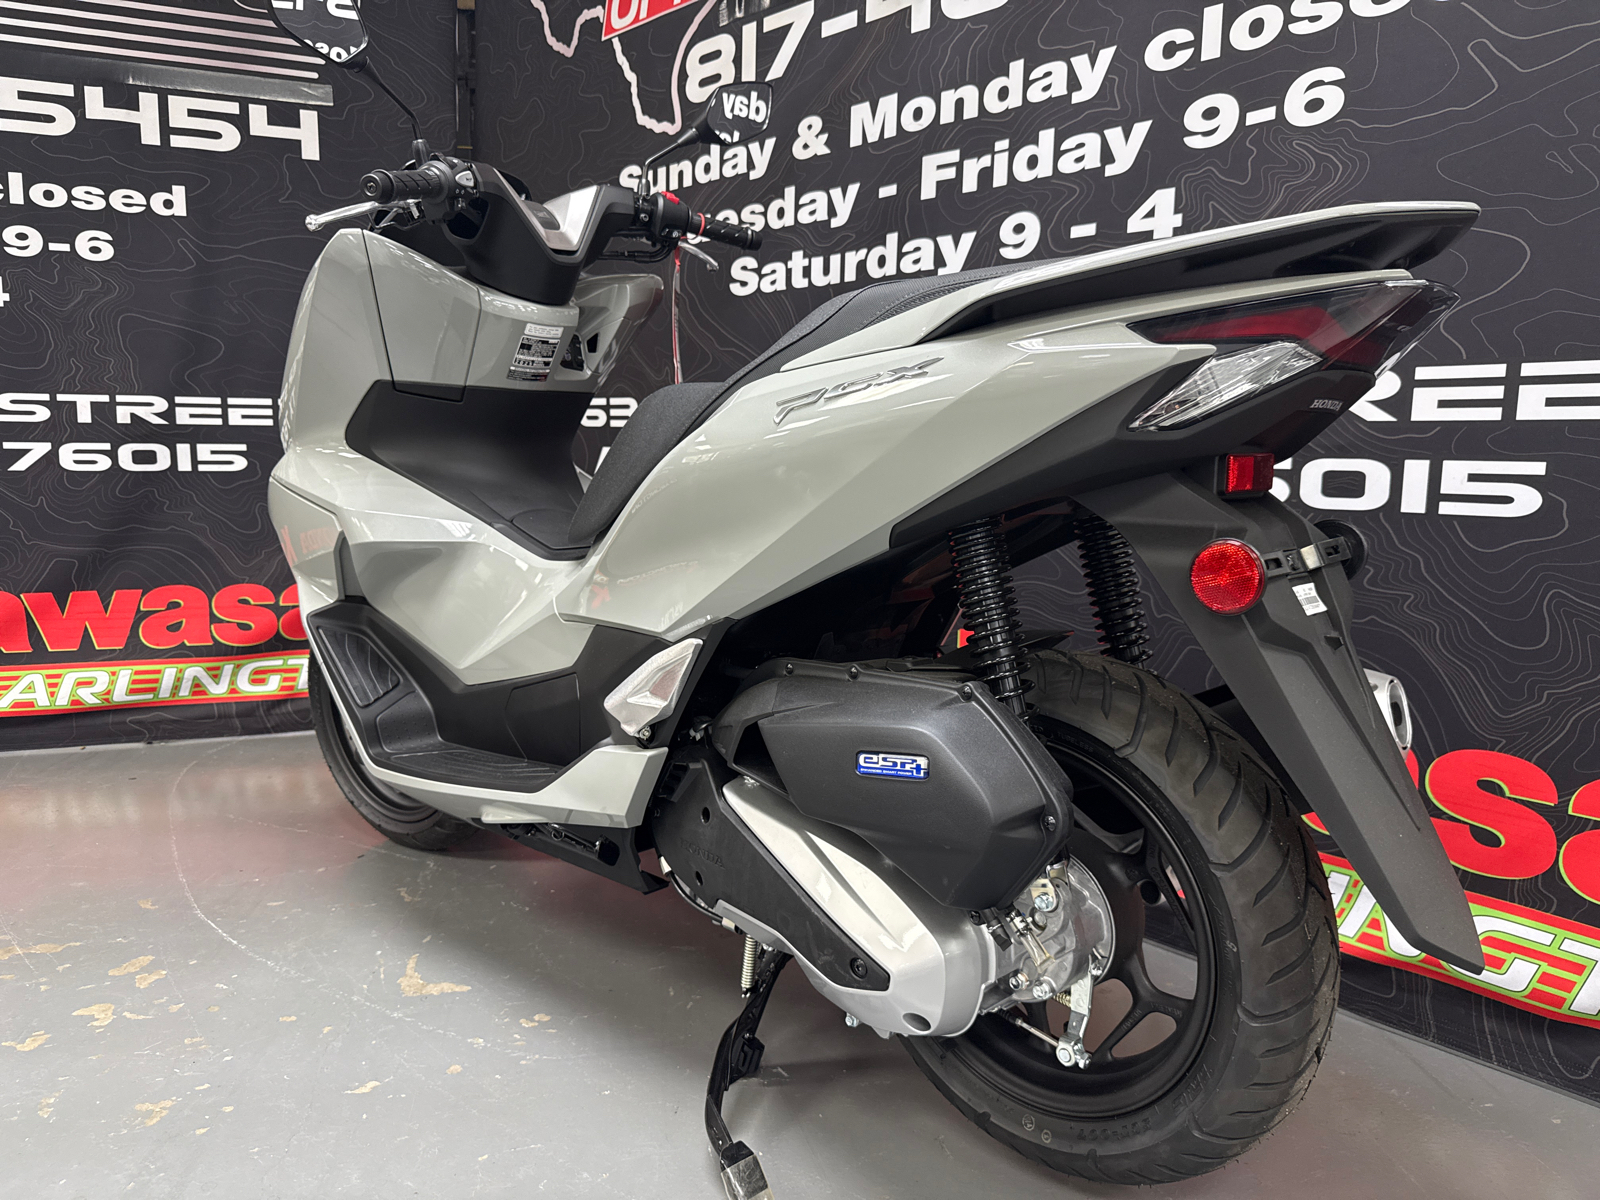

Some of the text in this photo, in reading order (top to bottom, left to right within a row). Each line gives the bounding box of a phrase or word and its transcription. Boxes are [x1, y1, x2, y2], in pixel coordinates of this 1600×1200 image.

[0, 76, 320, 161] 5454
[619, 137, 777, 194] Sunday
[792, 115, 831, 160] &
[850, 45, 1117, 148] Monday
[920, 119, 1152, 200] Friday
[1183, 66, 1346, 149] 9-6
[0, 172, 187, 217] losed
[2, 225, 115, 262] 9-6
[729, 230, 977, 296] Saturday
[999, 210, 1041, 260] 9
[1126, 187, 1183, 241] 4
[0, 392, 281, 427] STREE
[1309, 399, 1343, 412] HONDA
[2, 441, 248, 473] 76015
